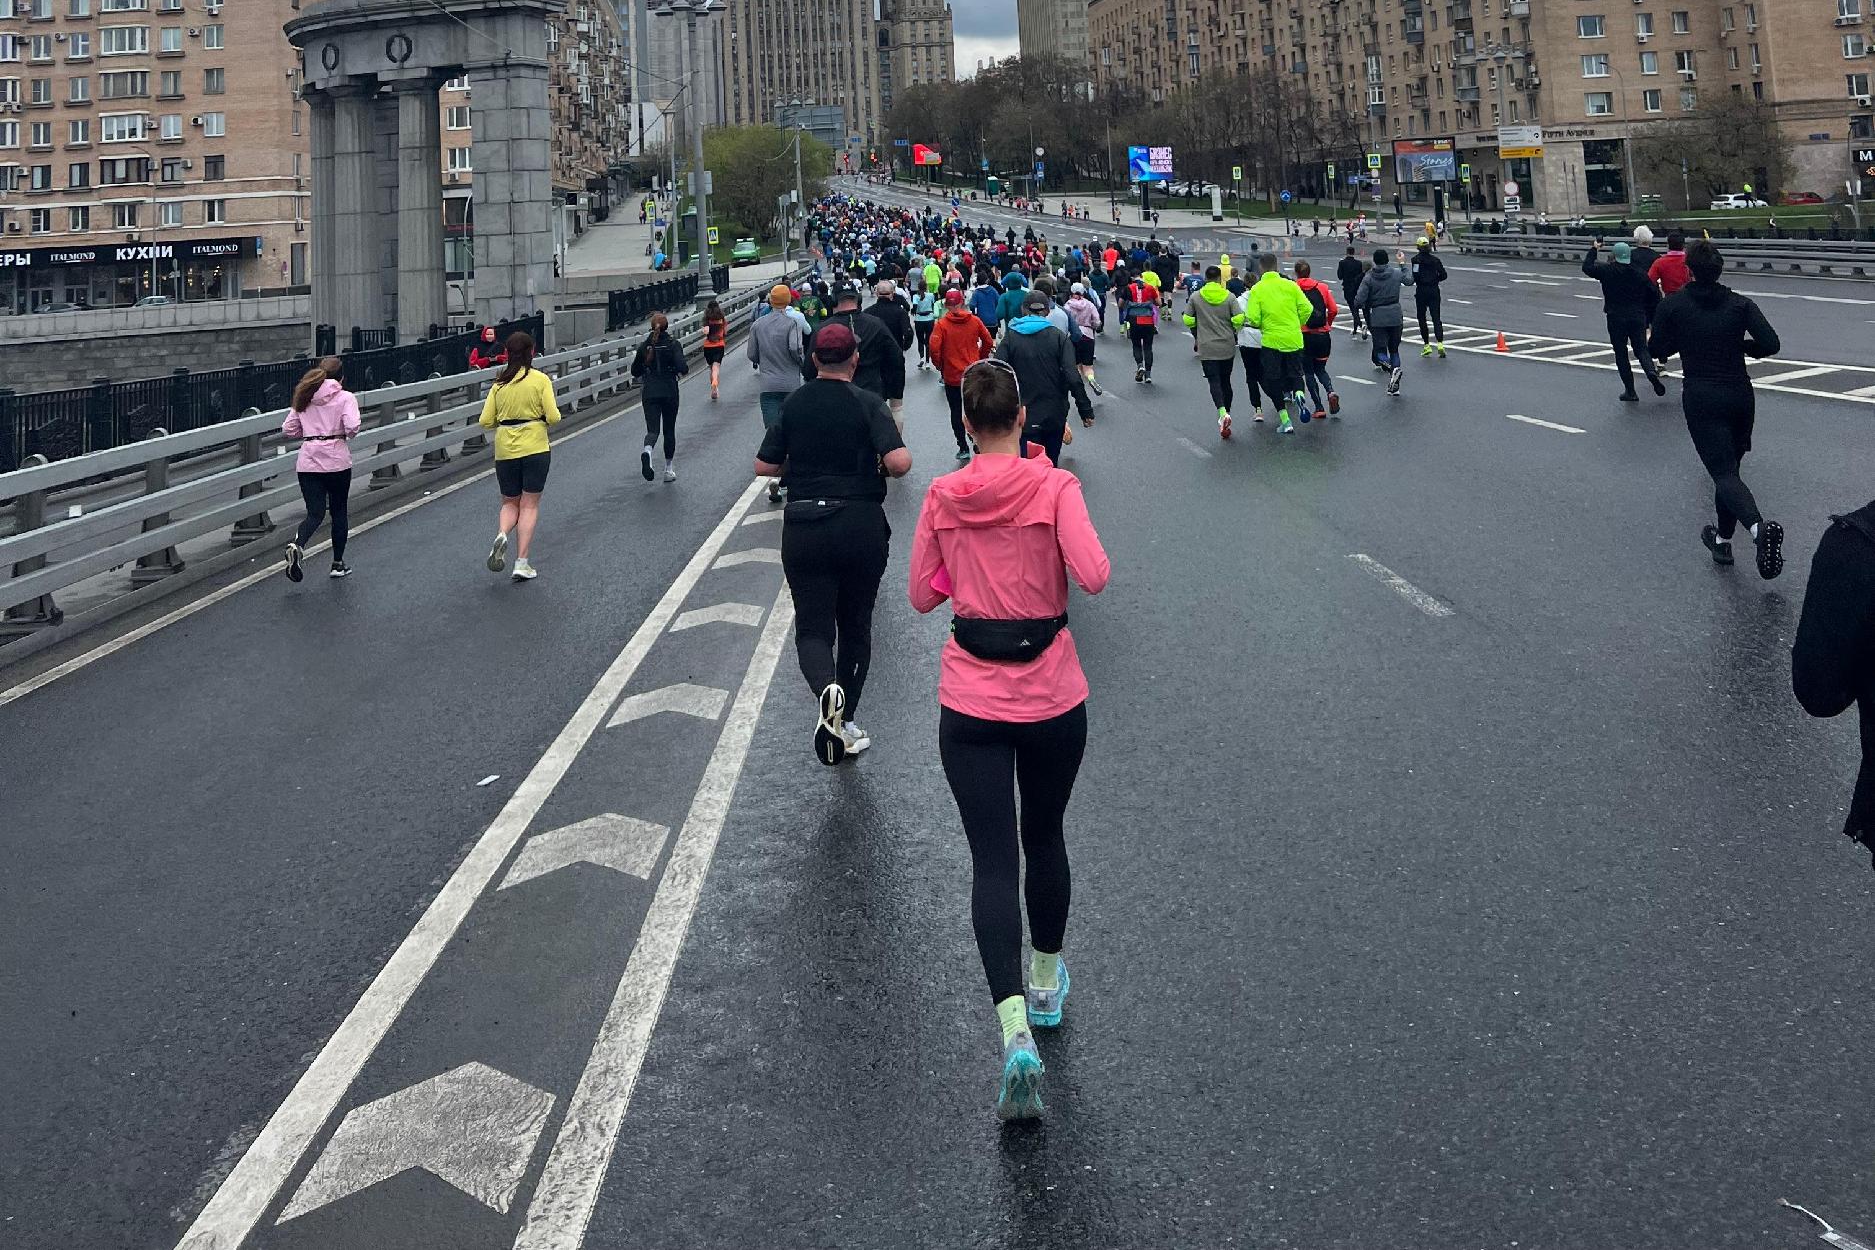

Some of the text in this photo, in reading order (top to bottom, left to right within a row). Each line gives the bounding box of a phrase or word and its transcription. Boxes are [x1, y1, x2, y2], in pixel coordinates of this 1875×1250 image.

[1542, 130, 1564, 139] FIFTH
[116, 245, 173, 260] КУХНИ
[192, 244, 238, 254] ITALMOND
[50, 251, 96, 261] ITALMOND
